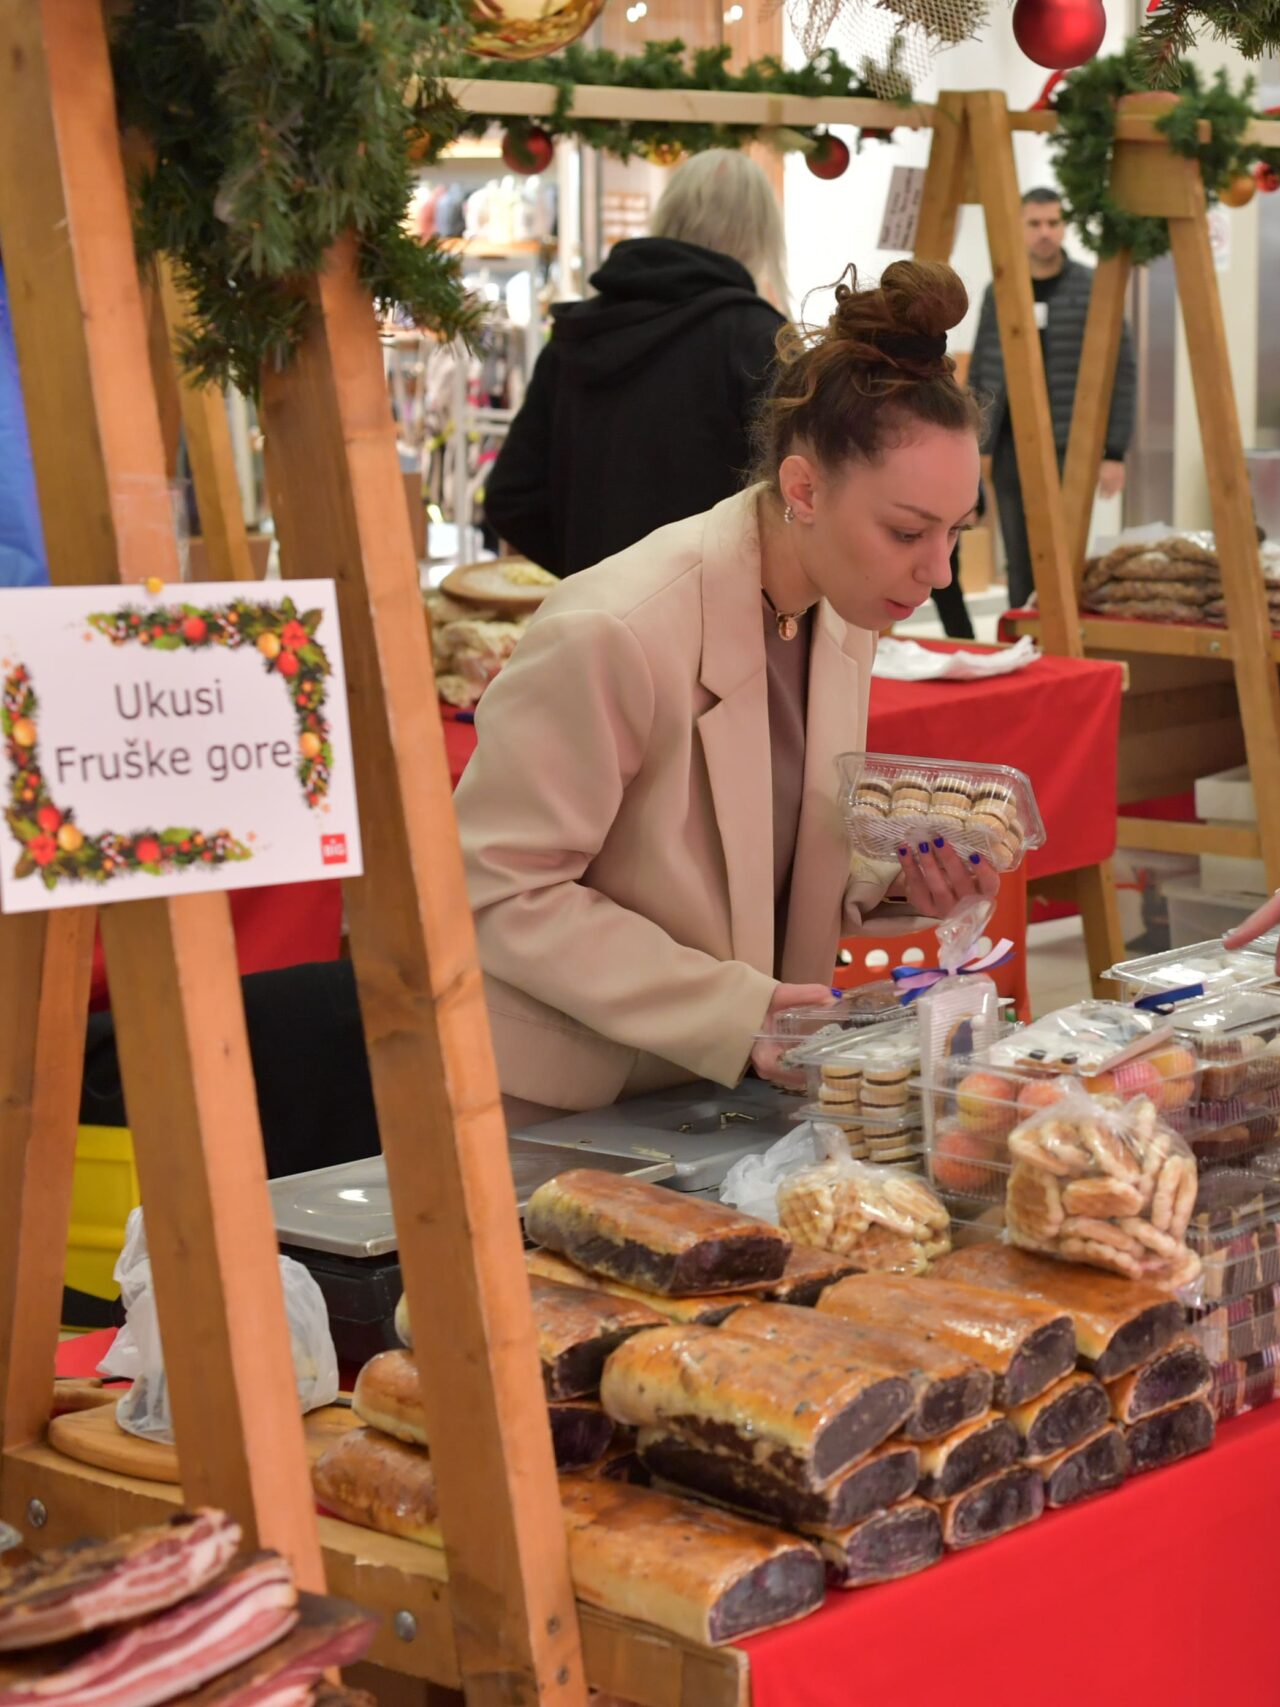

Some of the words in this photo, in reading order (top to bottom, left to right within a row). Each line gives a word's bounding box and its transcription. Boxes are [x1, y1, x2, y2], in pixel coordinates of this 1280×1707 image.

[114, 678, 224, 720] Ukusi
[55, 738, 192, 783] Fruške
[206, 740, 292, 782] gore
